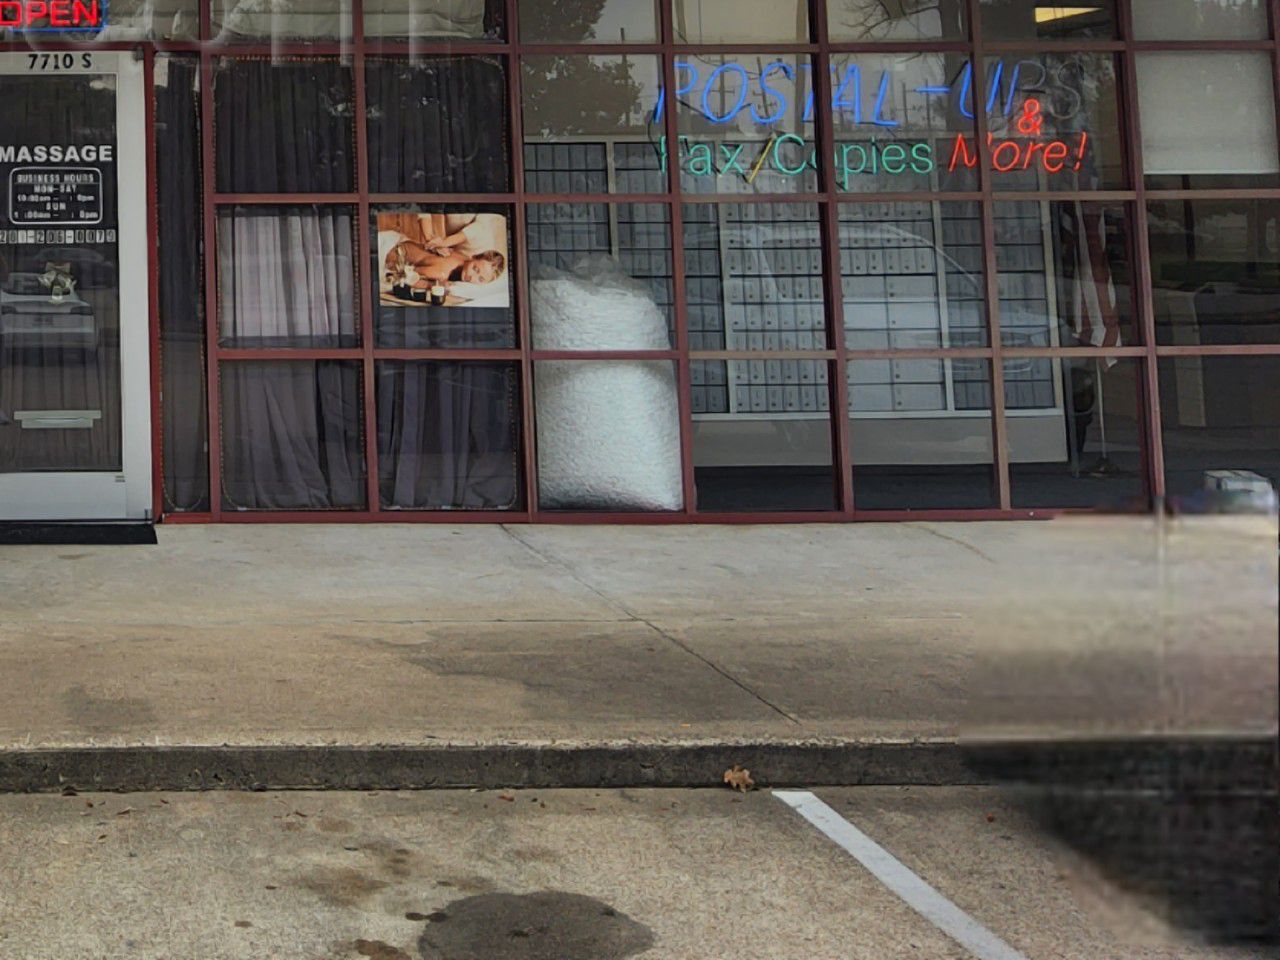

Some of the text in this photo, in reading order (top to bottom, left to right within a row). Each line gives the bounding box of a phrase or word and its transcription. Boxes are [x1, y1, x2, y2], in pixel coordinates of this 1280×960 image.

[28, 53, 92, 69] 7710 S
[1018, 98, 1044, 135] &
[17, 174, 94, 183] BUSINESS HOURS
